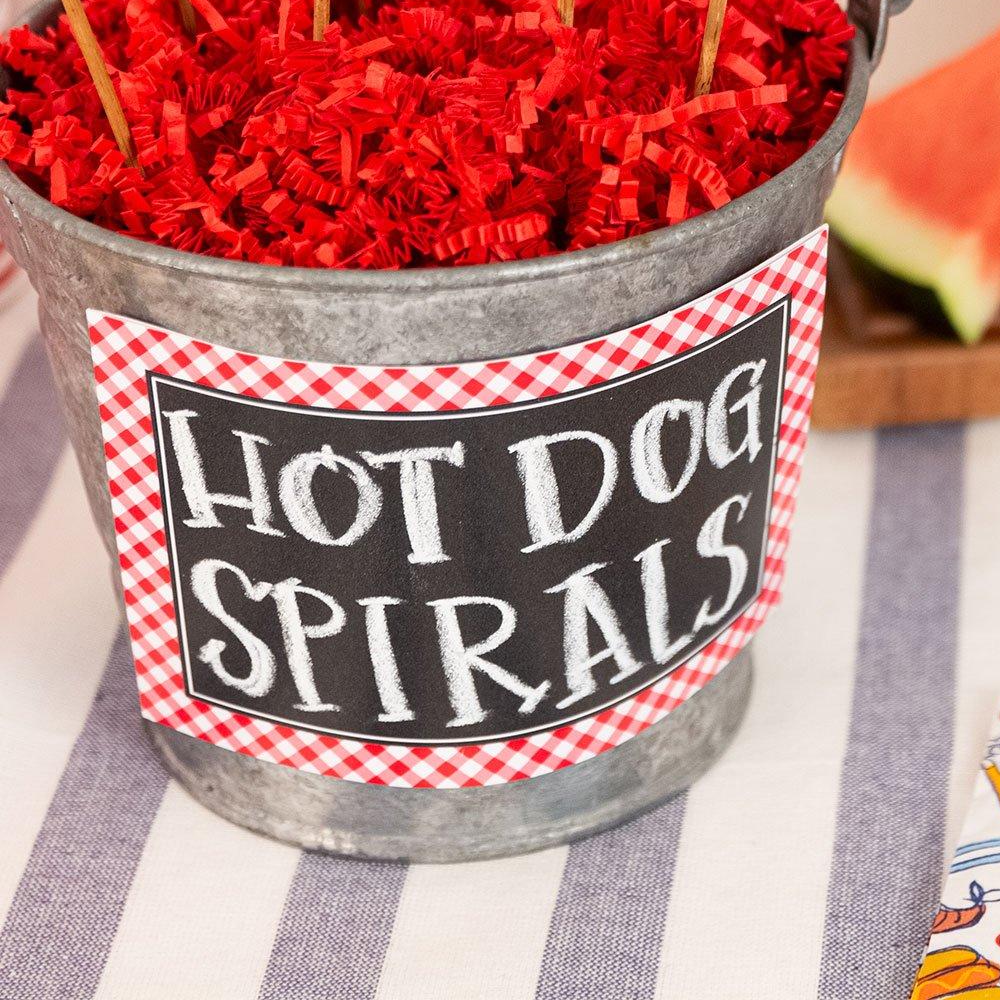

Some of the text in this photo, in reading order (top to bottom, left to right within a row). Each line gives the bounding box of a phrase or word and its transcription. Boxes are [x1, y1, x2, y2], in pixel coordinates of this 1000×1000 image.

[164, 358, 768, 566] HOT DOG
[190, 491, 753, 728] SPIRALS
